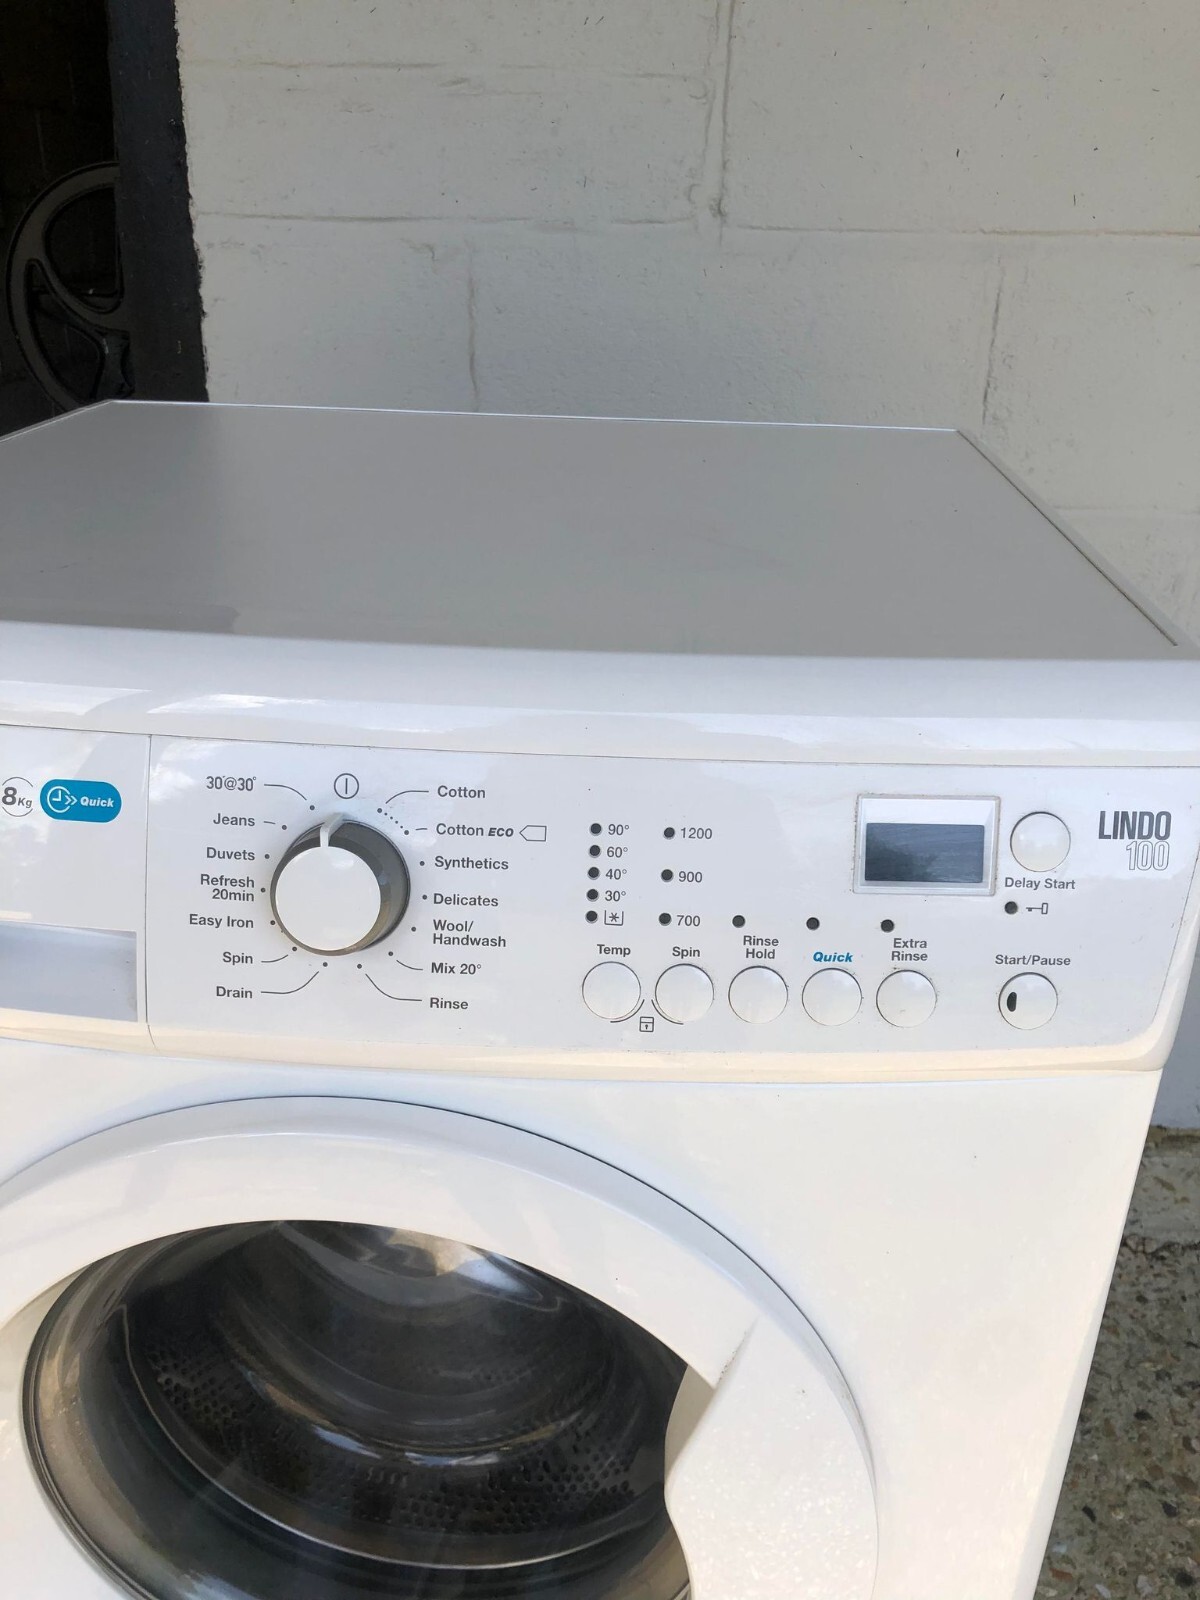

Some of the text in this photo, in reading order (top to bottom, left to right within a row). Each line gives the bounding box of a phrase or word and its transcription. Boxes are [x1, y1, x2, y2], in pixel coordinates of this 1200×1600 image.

[437, 786, 486, 799] Cotton
[80, 796, 114, 808] Quick
[213, 813, 255, 827] Jeans
[1099, 811, 1172, 840] LINDO
[436, 824, 514, 837] Cotton ECO
[680, 827, 713, 840] 1200
[206, 846, 255, 861] Duvets
[1126, 840, 1170, 871] 100
[434, 856, 509, 870] Synthetics
[200, 873, 255, 888] Refresh
[678, 871, 703, 883] 900
[1004, 877, 1076, 891] Delay Start
[212, 888, 255, 902] 20min
[433, 893, 499, 907] Delicates
[189, 914, 254, 929] Easy Iron
[433, 919, 474, 932] Wool/
[676, 915, 700, 927] 700
[433, 934, 507, 948] Handwash
[743, 935, 779, 947] Rinse
[893, 938, 927, 949] Extra
[597, 944, 631, 957] Temp
[672, 946, 701, 959] Spin
[746, 948, 776, 960] Hold
[891, 951, 928, 962] Rinse
[222, 951, 253, 965] Spin
[813, 952, 853, 963] Quick
[995, 954, 1071, 966] Start/Pause
[431, 962, 455, 975] Mix
[216, 986, 253, 999] Drain
[430, 998, 469, 1010] Rinse
